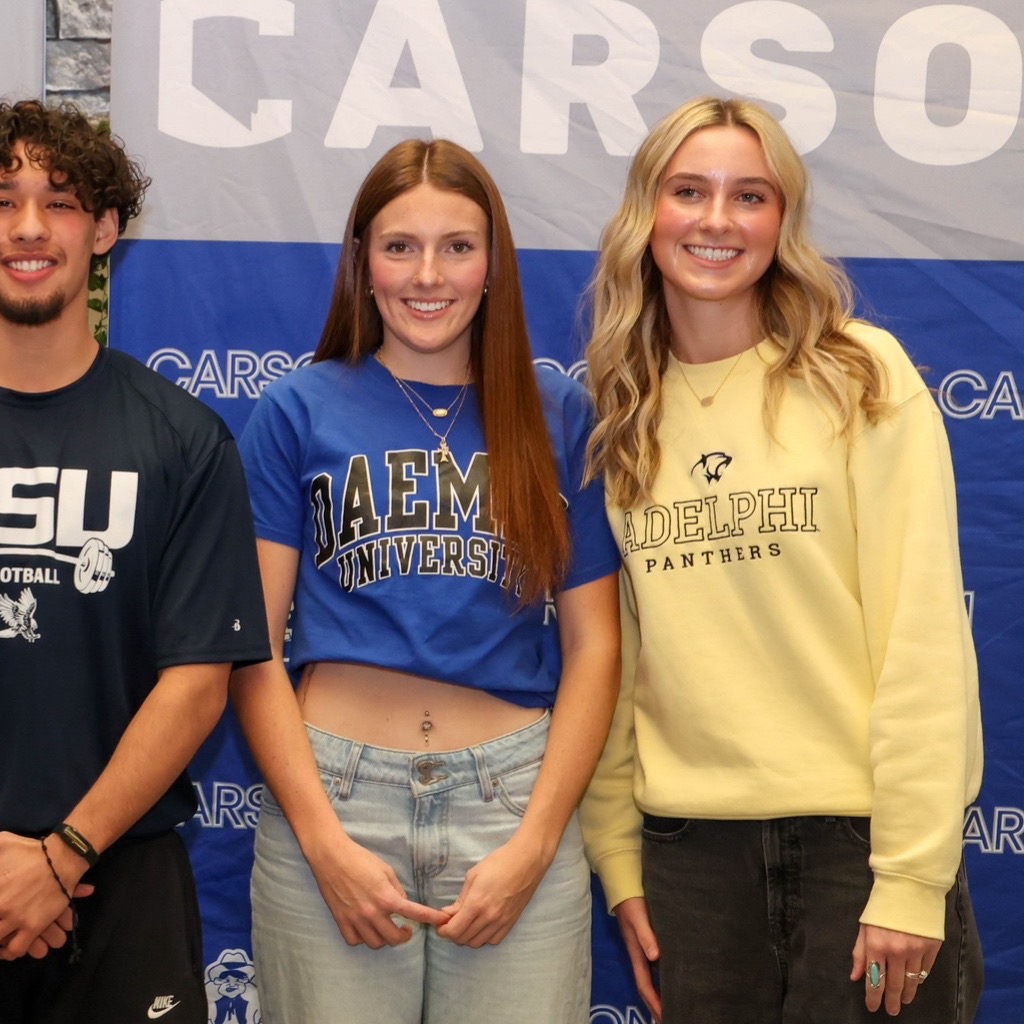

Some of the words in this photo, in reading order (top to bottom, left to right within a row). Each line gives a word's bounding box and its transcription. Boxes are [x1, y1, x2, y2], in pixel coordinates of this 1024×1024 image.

[158, 0, 1024, 166] CARSO
[146, 348, 316, 399] CARS
[310, 449, 510, 570] DAEM
[622, 487, 818, 557] ADELPHI
[646, 544, 781, 573] PANTHERS
[152, 995, 174, 1009] NIKE
